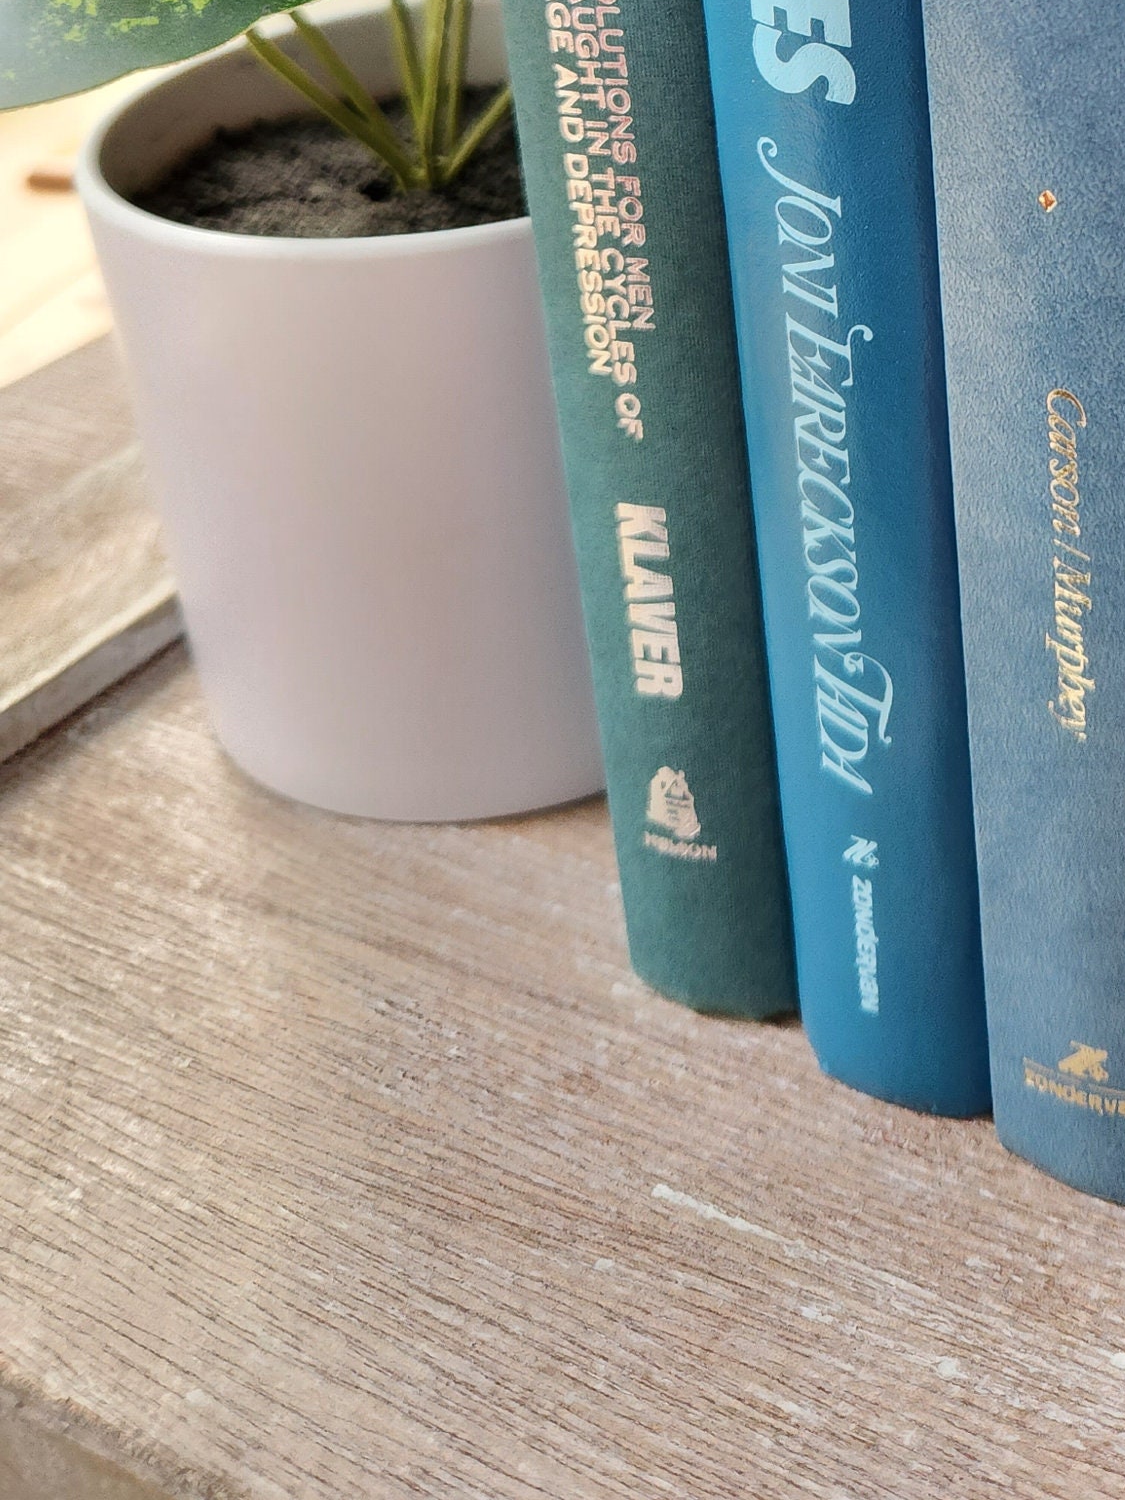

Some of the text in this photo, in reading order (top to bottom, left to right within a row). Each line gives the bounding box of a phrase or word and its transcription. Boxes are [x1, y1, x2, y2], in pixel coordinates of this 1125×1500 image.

[553, 63, 584, 143] AND
[585, 121, 612, 155] IN
[591, 167, 622, 237] THE
[615, 175, 647, 247] FOR
[563, 153, 613, 376] DEPRESSION
[626, 256, 657, 331] MEN
[600, 247, 637, 387] CYCLES
[615, 392, 644, 441] OF
[757, 136, 894, 796] JONI EARECKSON TADA
[1046, 388, 1088, 538] Carson
[616, 501, 684, 700] KLAVER
